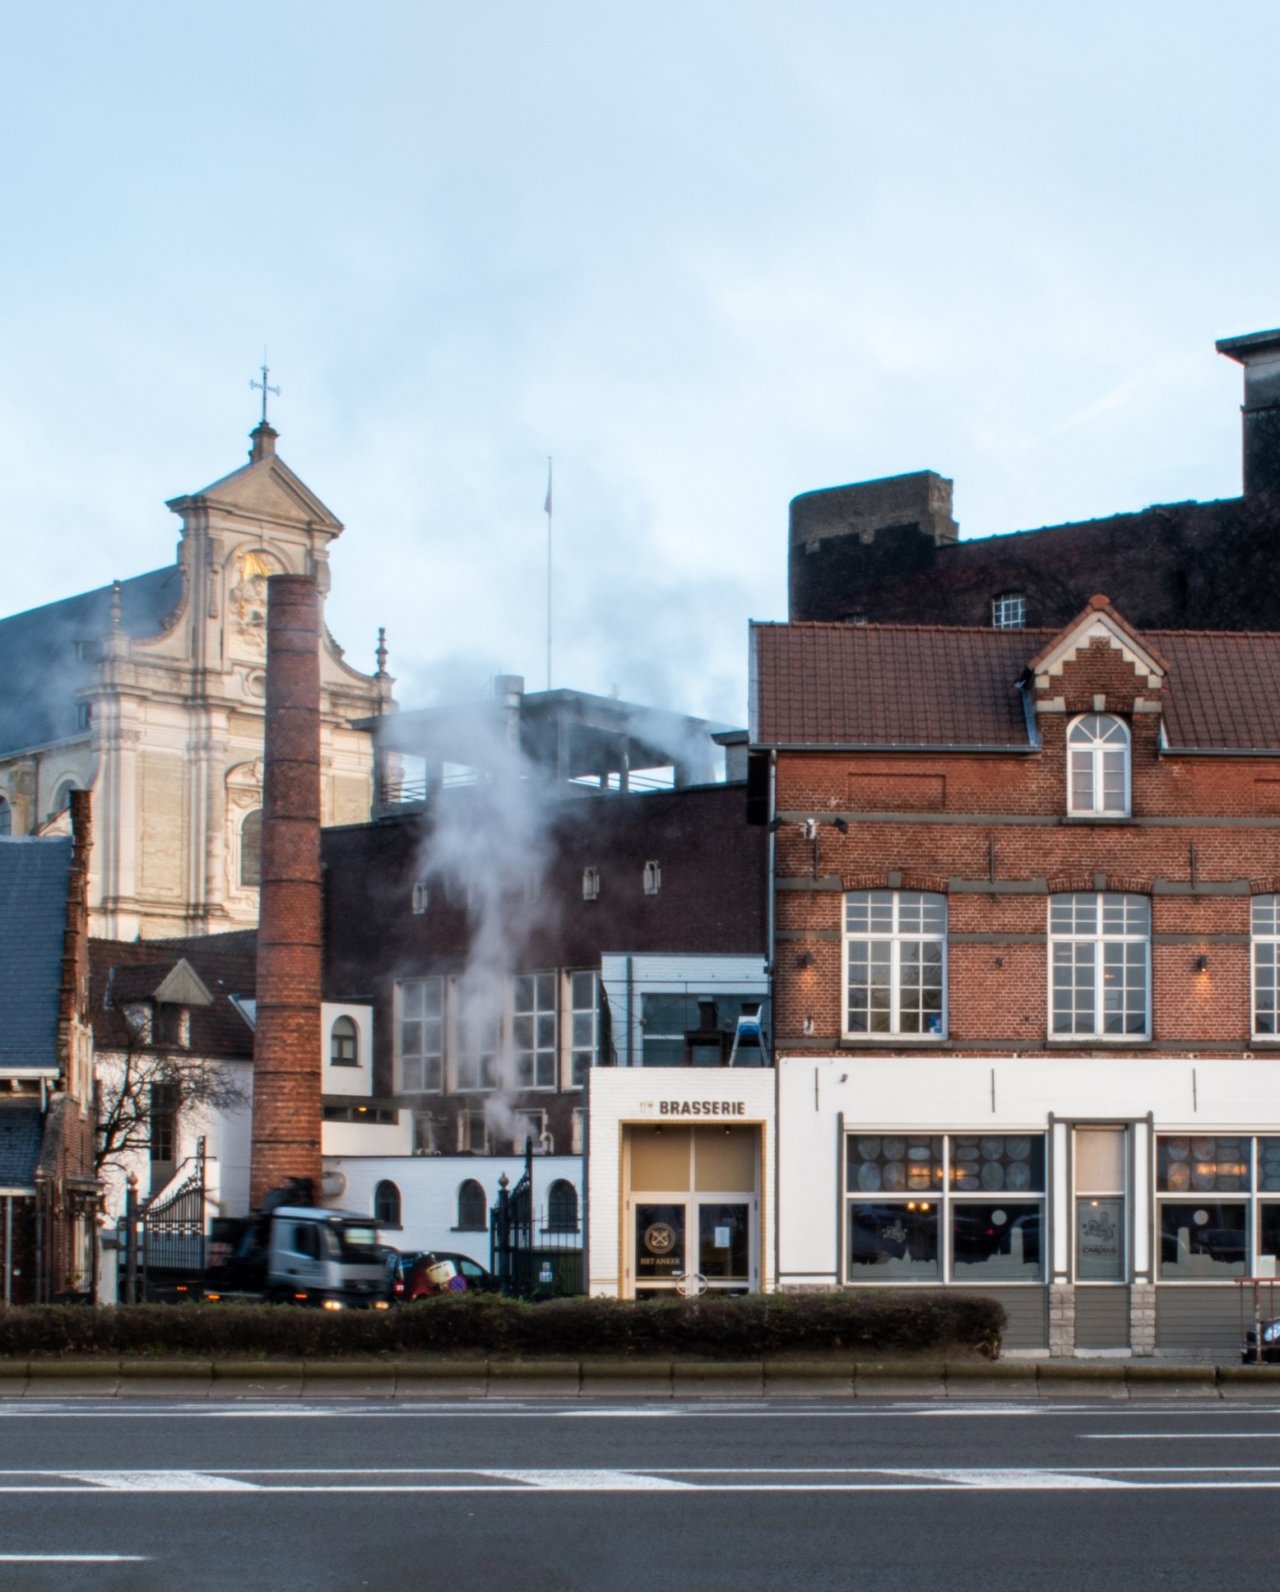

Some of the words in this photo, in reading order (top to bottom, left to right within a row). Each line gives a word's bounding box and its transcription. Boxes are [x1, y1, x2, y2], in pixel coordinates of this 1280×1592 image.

[660, 1101, 745, 1115] BRASSERIE
[640, 1257, 655, 1265] HET
[655, 1257, 681, 1265] ANKER
